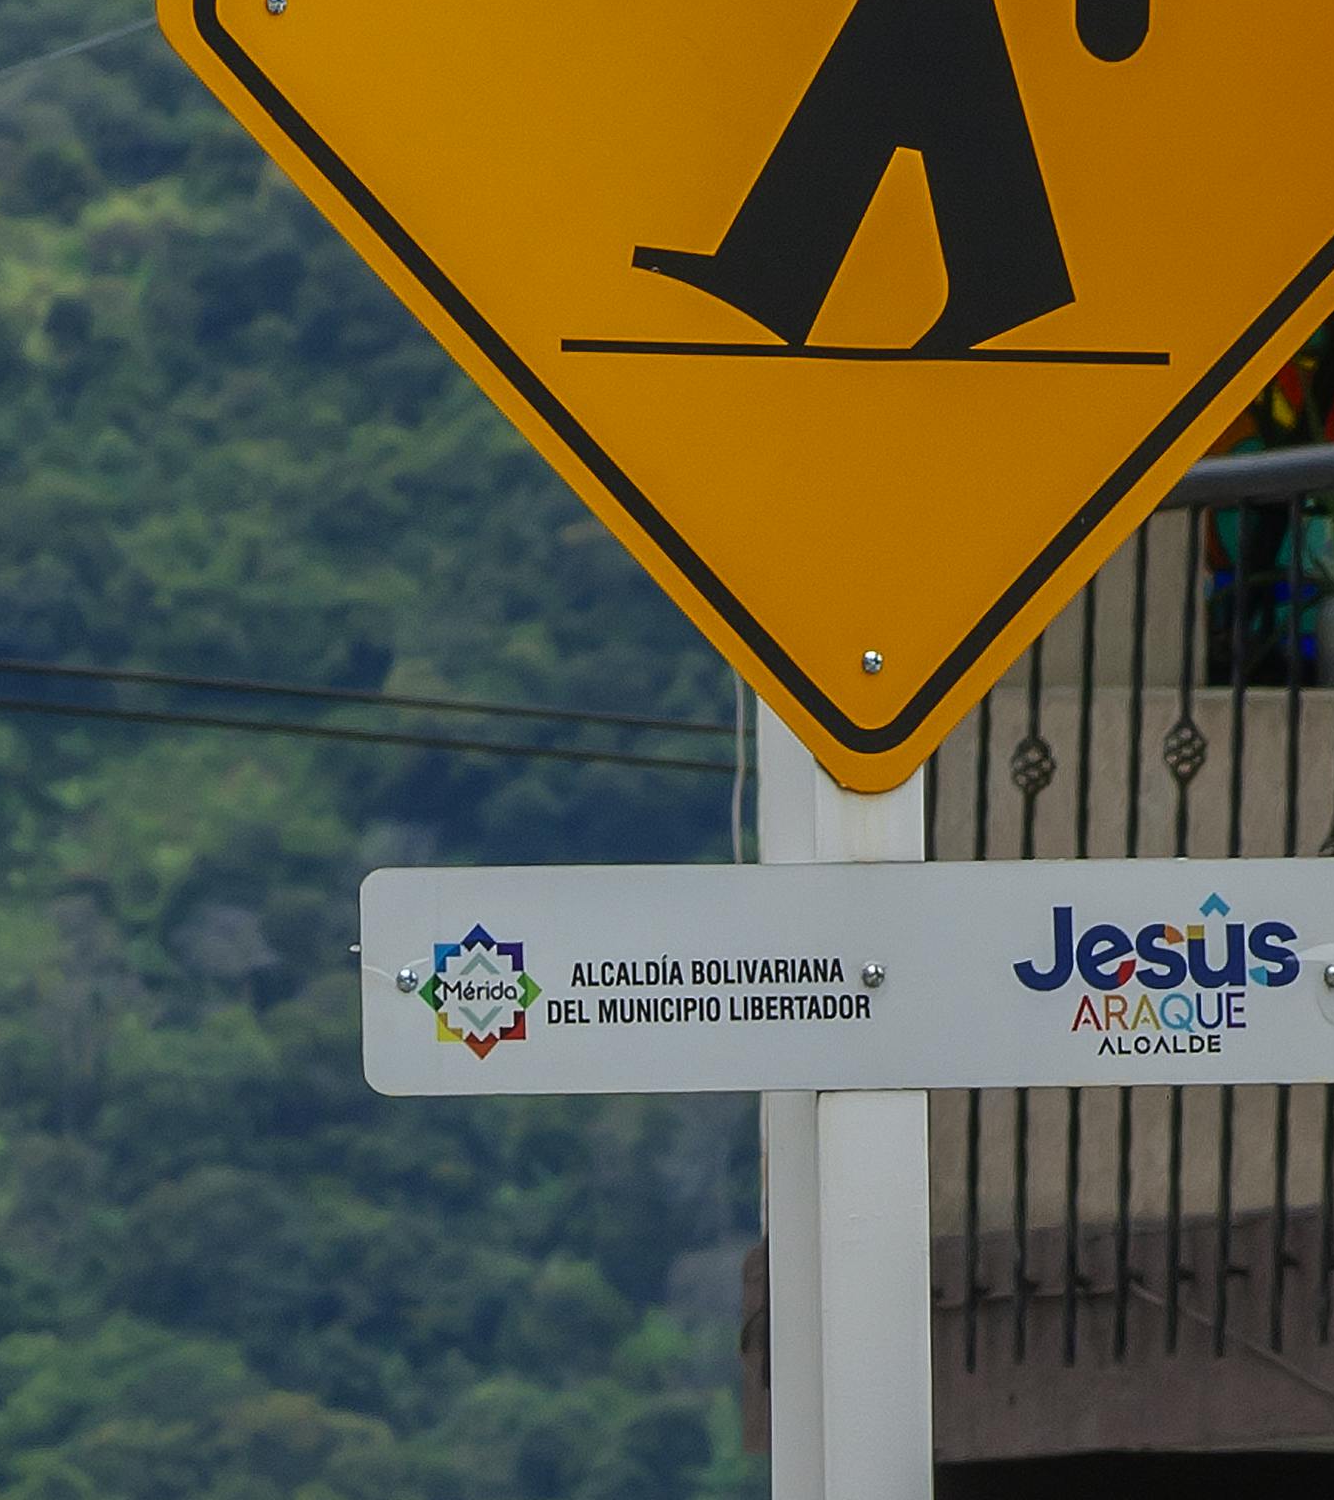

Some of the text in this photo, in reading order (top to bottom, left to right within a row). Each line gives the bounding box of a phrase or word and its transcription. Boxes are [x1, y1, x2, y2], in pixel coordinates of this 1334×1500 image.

[571, 954, 844, 987] ALCALDÍA BOLIVARIANA
[442, 979, 518, 1002] Mérida
[547, 994, 871, 1025] DEL MUNICIPIO LIBERTADOR
[1071, 991, 1246, 1032] ARAQUE
